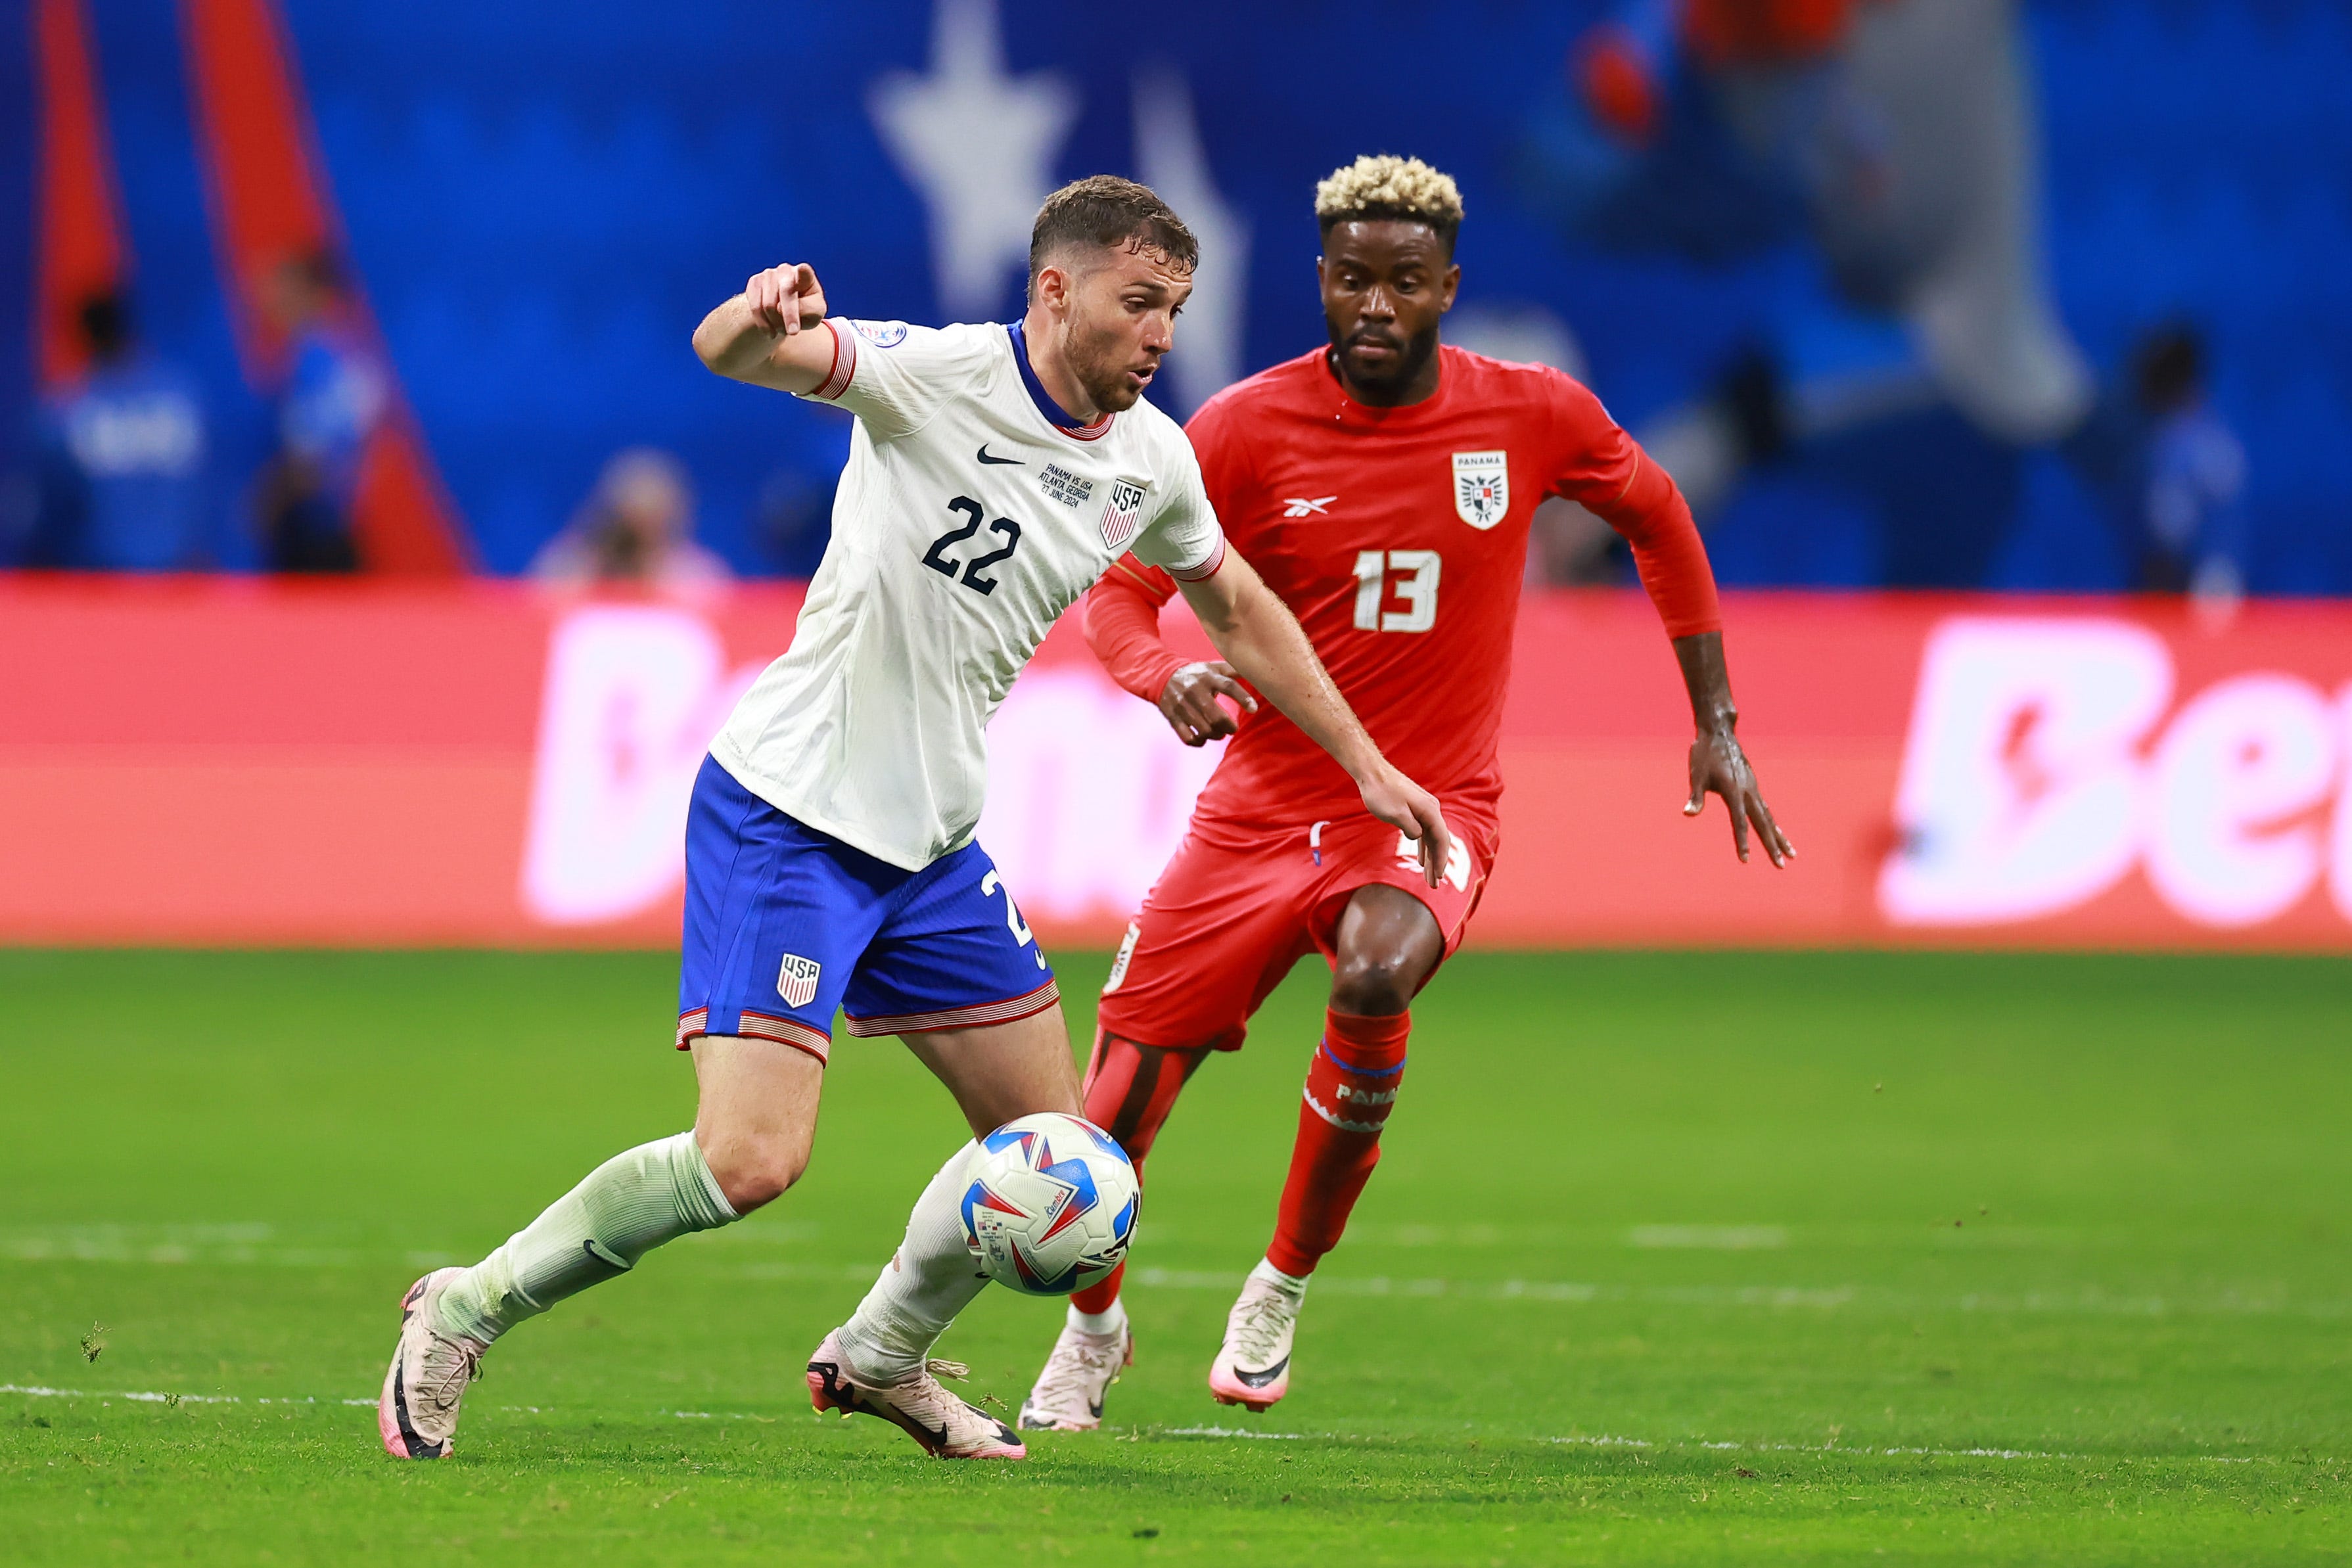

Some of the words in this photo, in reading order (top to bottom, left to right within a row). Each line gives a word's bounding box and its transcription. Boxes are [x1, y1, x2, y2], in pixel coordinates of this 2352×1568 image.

[1038, 472, 1065, 492] ATLANTA,
[1066, 485, 1090, 501] GEORGIA
[1046, 463, 1072, 482] PANAMA
[1072, 476, 1081, 486] VS.
[1080, 480, 1093, 492] USA
[1042, 484, 1049, 494] 27
[1049, 488, 1065, 501] JUNE
[1063, 495, 1079, 508] 2024
[1113, 483, 1143, 511] USA
[921, 496, 1021, 596] 22
[1352, 549, 1442, 634] 13
[1878, 611, 2352, 928] Be
[784, 956, 818, 979] USA
